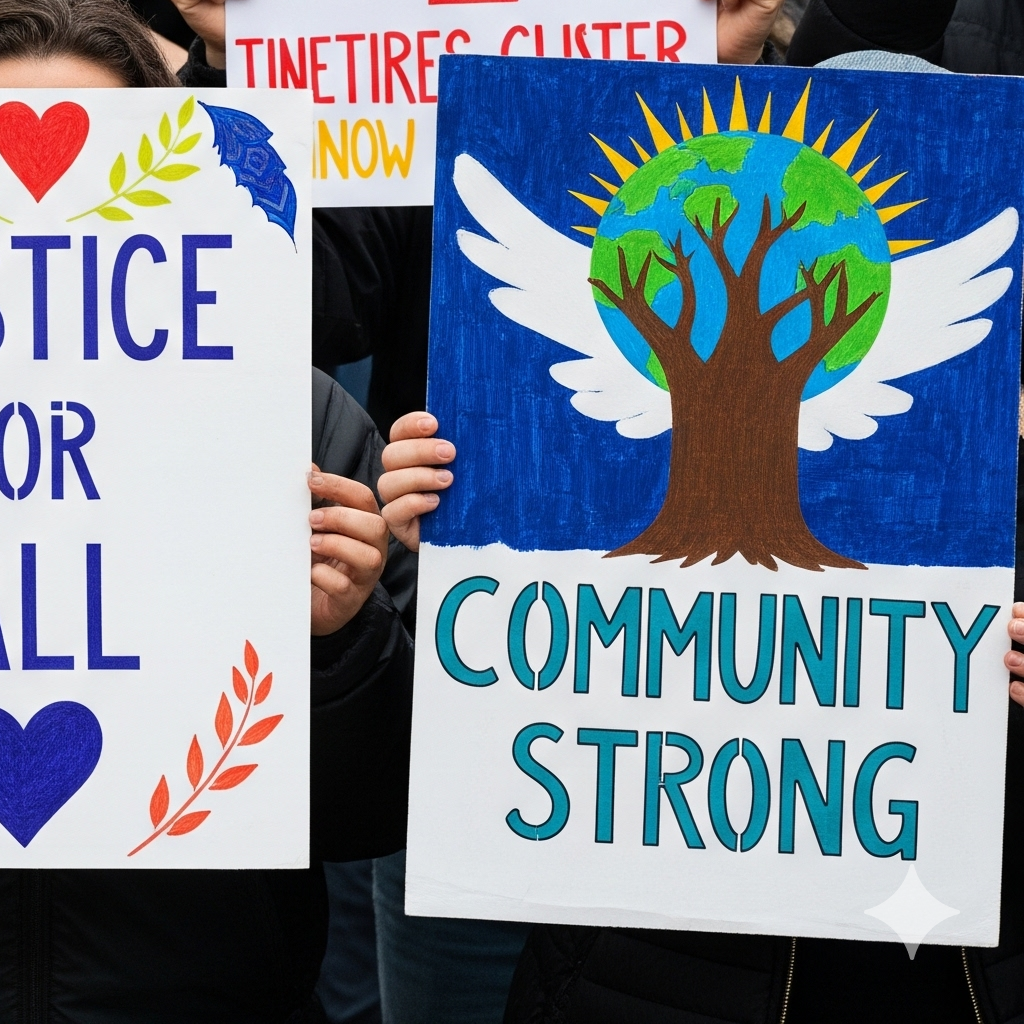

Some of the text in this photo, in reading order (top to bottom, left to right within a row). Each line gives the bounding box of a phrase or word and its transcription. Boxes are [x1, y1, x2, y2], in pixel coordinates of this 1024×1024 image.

[312, 118, 415, 180] NOW
[435, 576, 1001, 713] COMMUNITY
[505, 722, 919, 861] STRONG
